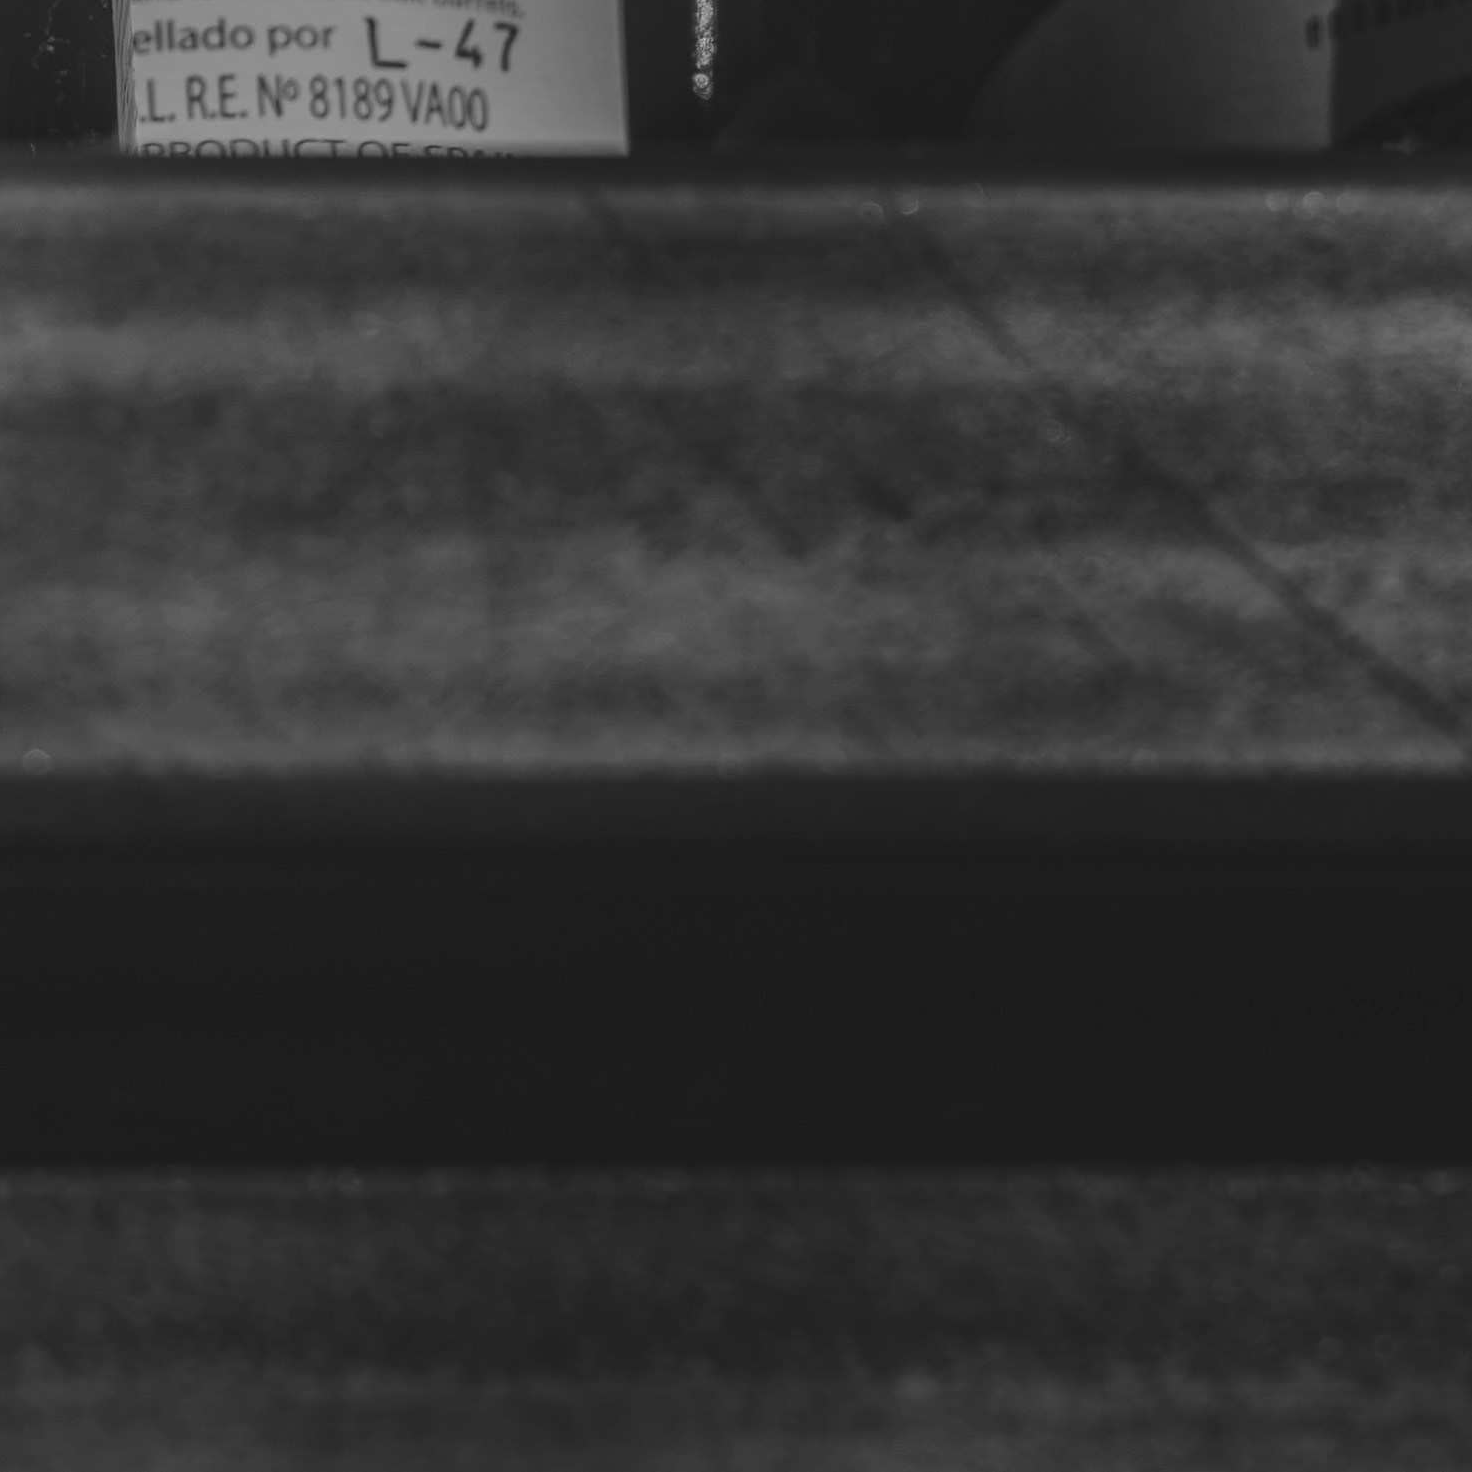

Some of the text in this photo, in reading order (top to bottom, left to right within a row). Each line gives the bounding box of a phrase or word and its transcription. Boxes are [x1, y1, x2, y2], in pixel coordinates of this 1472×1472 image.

[132, 18, 335, 57] ellado por
[308, 74, 395, 122] 8189
